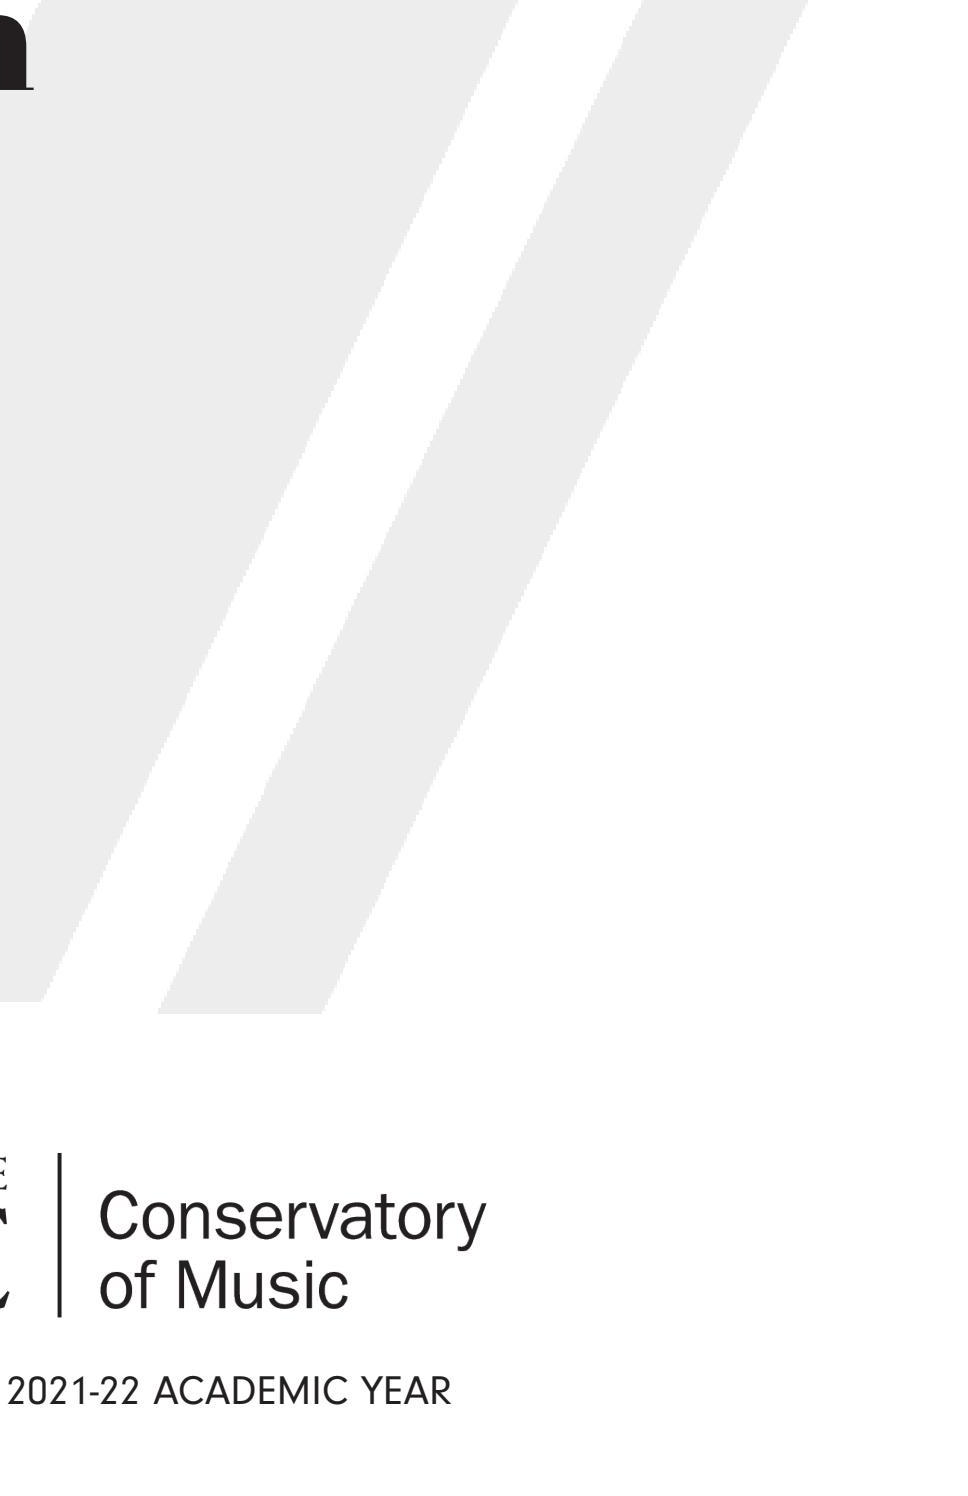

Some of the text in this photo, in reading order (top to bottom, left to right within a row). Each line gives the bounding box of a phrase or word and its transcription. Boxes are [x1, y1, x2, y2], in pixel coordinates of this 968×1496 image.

[100, 1190, 486, 1251] Conservatory
[100, 1260, 347, 1309] of Music
[8, 1376, 138, 1404] 2021-22
[154, 1376, 347, 1405] ACADEMIC
[361, 1376, 451, 1404] YEAR
